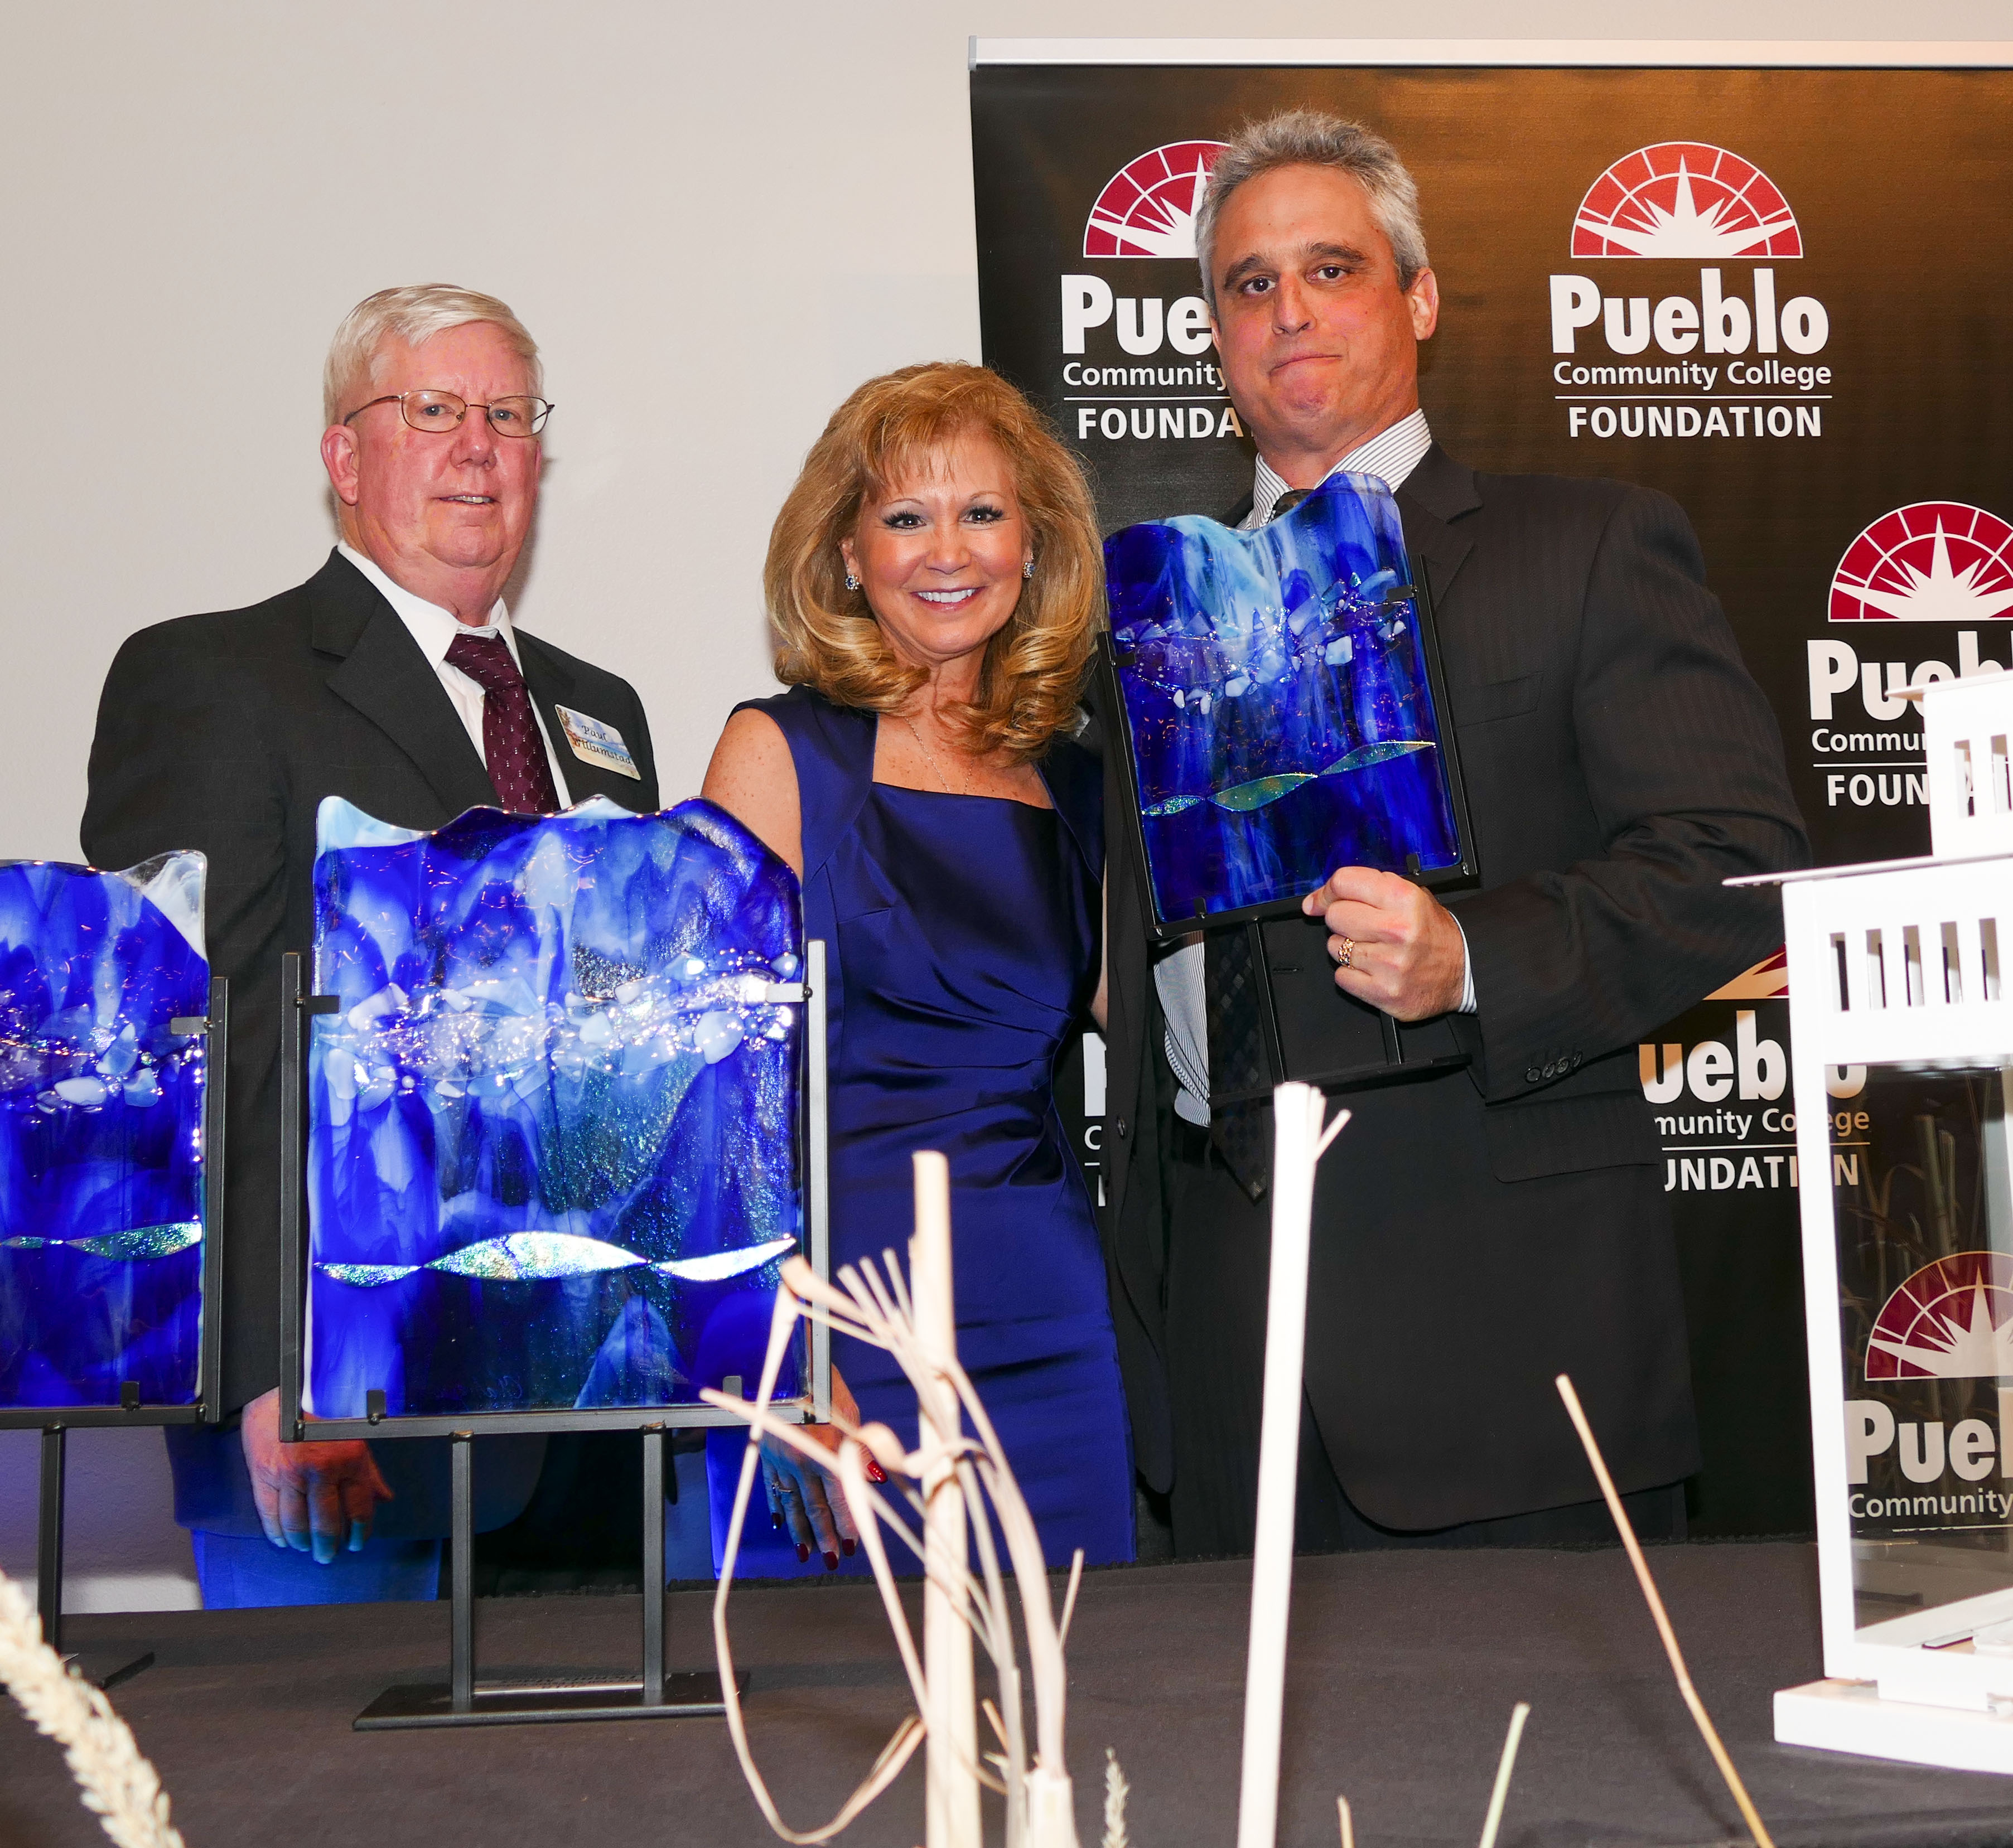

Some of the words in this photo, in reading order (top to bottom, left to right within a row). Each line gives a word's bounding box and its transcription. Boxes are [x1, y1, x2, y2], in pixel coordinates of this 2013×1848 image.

[1061, 274, 1212, 355] Pue
[1549, 268, 1829, 354] Pueblo
[1553, 360, 1718, 391] Community
[1727, 360, 1832, 391] College
[1078, 407, 1244, 439] FOUNDA
[1568, 406, 1822, 438] FOUNDATION
[582, 725, 608, 742] Paul
[1812, 728, 1926, 752] Commu
[1639, 1010, 1867, 1104] ueb
[1654, 1109, 1753, 1140] munity
[1762, 1108, 1870, 1137] Coge
[1664, 1154, 1858, 1192] NDATIN
[1843, 1387, 2013, 1485] Pue
[1848, 1487, 2013, 1519] Community
